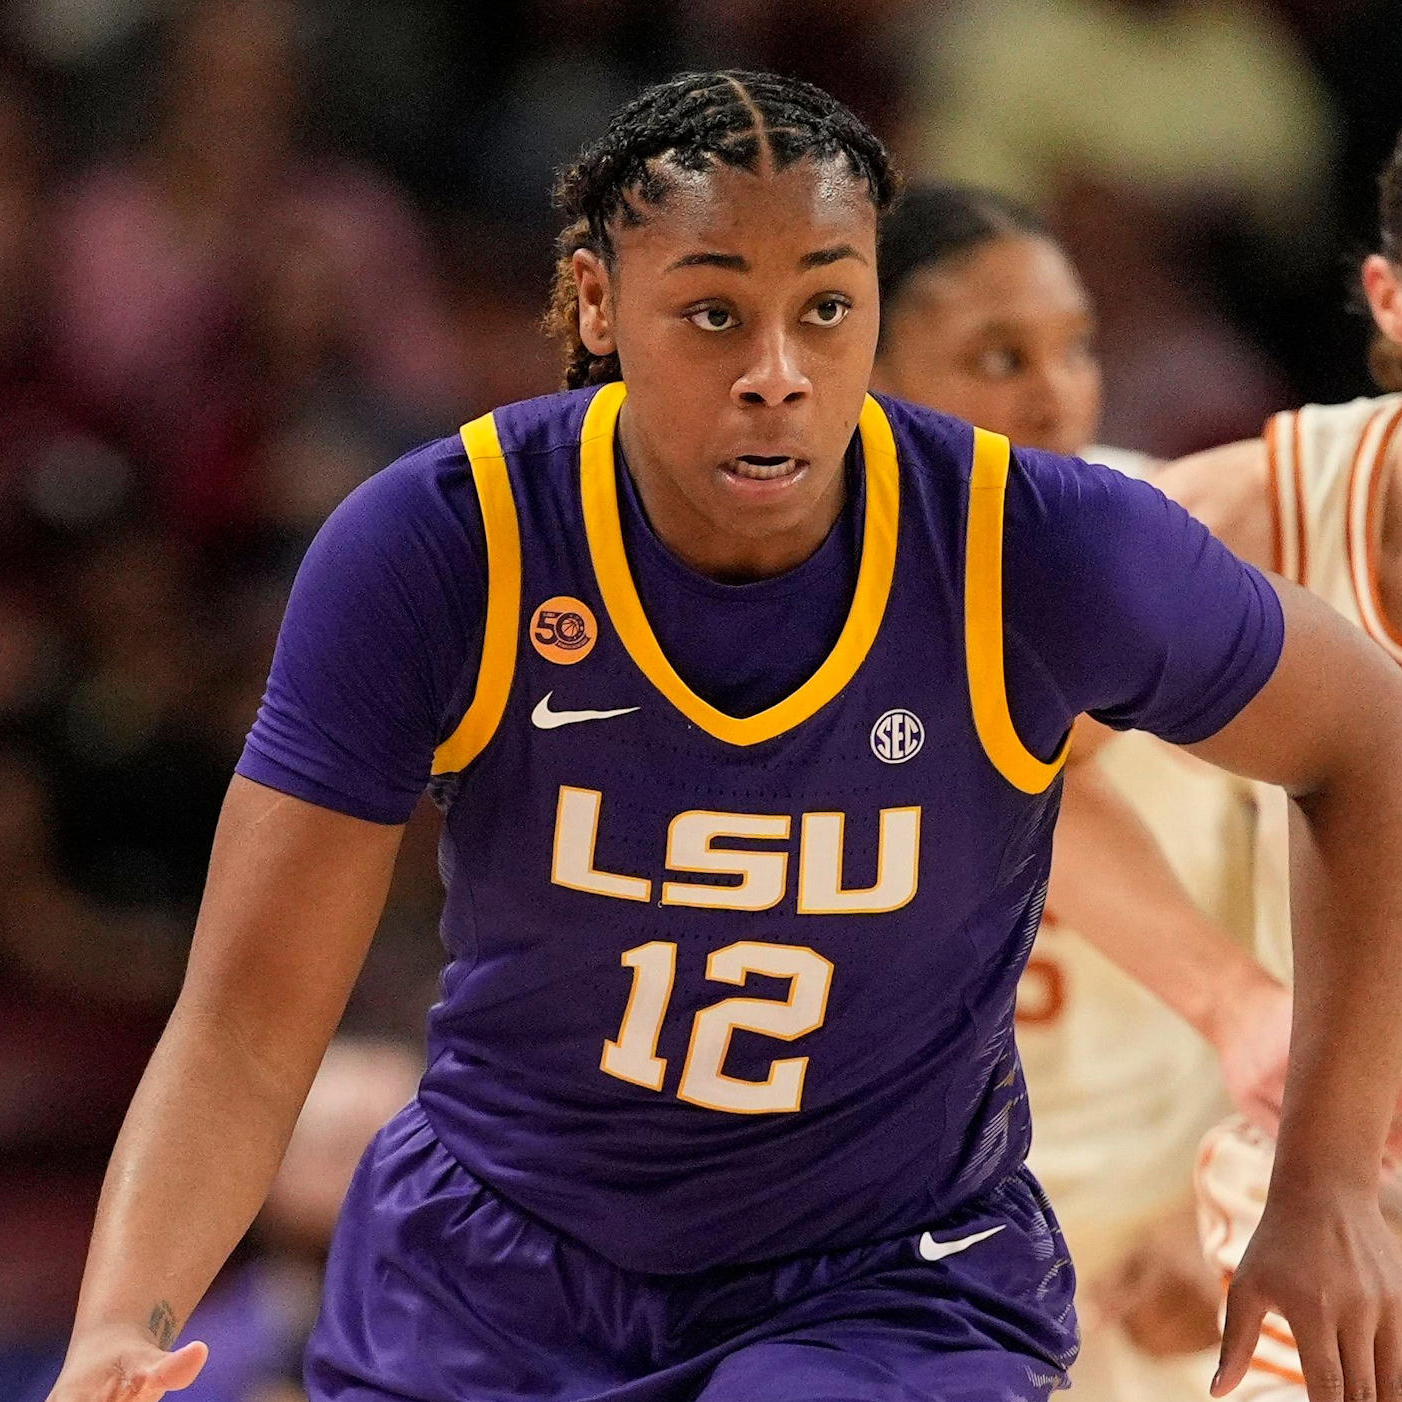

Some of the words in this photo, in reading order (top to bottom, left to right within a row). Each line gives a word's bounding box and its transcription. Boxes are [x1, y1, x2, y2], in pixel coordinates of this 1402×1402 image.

[535, 611, 585, 645] 50
[876, 713, 919, 759] SEC
[551, 785, 922, 915] LSU
[600, 940, 834, 1115] 12
